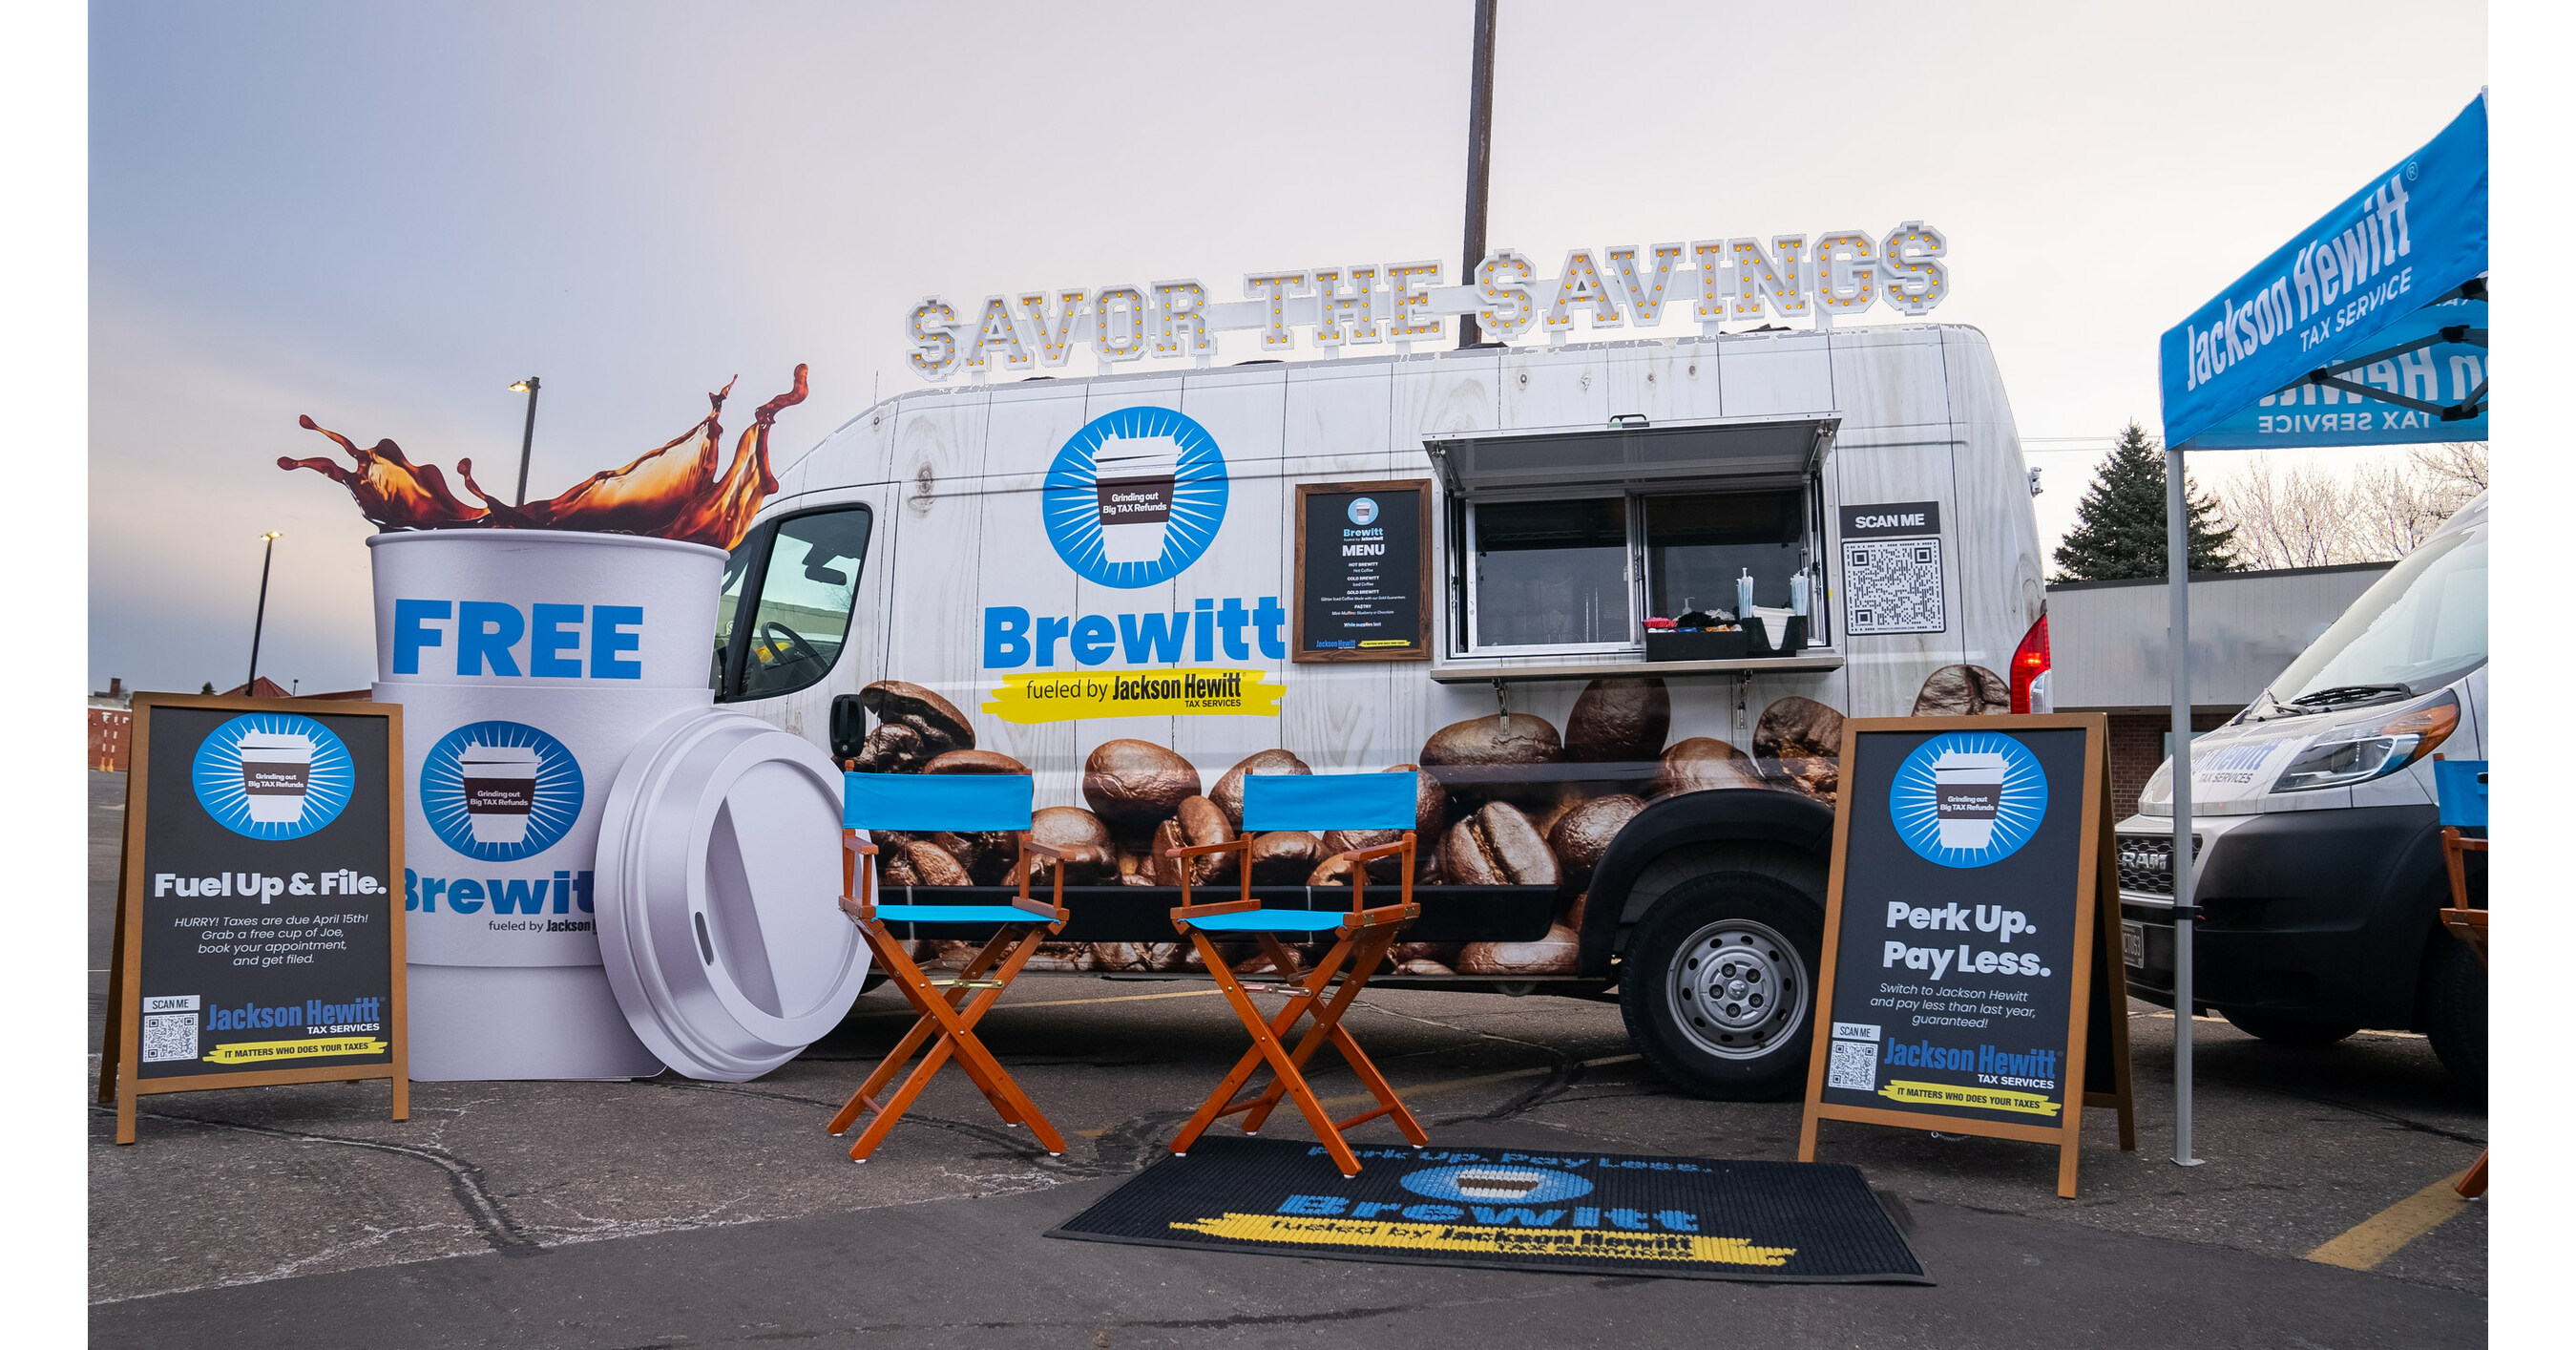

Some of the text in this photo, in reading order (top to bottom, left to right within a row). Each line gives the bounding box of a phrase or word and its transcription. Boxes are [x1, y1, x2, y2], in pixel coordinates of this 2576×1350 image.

[1243, 259, 1444, 350] THE
[2300, 266, 2413, 352] TAX SERVICE
[2187, 277, 2293, 392] Jackson
[1112, 492, 1159, 502] Grinding out
[1102, 502, 1167, 515] Big TAX Refunds
[1855, 514, 1925, 529] SCAN ME
[1343, 527, 1384, 537] Brewitt
[1342, 544, 1385, 557] MENU
[392, 599, 643, 680] FREE
[983, 596, 1285, 668] Brewitt
[1026, 672, 1242, 702] fueled by Jackson Hewitt
[1184, 699, 1242, 708] TAX SERVICES
[2211, 772, 2253, 783] SERVICES
[477, 791, 508, 799] Grinding
[1947, 795, 1976, 804] Grinding
[2122, 852, 2168, 869] RAM
[155, 868, 387, 904] Fuel Up & File.
[175, 914, 368, 927] HURRY! Taxes are due April 15th!
[489, 920, 526, 931] fueled
[530, 921, 544, 933] by
[546, 919, 591, 933] Jackson
[1886, 901, 2037, 943] Perk Up.
[201, 926, 345, 941] Grab a free cup of Joe,
[198, 939, 347, 955] book your appointment,
[233, 954, 315, 968] and get filed.
[1883, 940, 2051, 981] Pay Less.
[1880, 982, 2028, 1002] Switch to Jackson Hewitt
[152, 999, 189, 1010] SCAN ME
[1871, 997, 2036, 1019] and pay less than last year,
[206, 997, 380, 1031] Jackson Hewitt
[1912, 1015, 1989, 1028] guaranteed!
[306, 1023, 380, 1035] TAX SERVICES
[1840, 1026, 1871, 1038] SCAN ME
[224, 1042, 369, 1059] IT MATTERS WHO DOES YOUR TAXES
[1884, 1037, 2055, 1079] Jackson Hewitt
[1978, 1074, 2055, 1089] TAX SERVICES
[1897, 1086, 2040, 1109] IT MATTERS WHO DOES YOUR TAXES
[1276, 1194, 1699, 1232] Brewitt
[1436, 1227, 1575, 1246] Jackson
[1581, 1233, 1692, 1251] Hewitt
